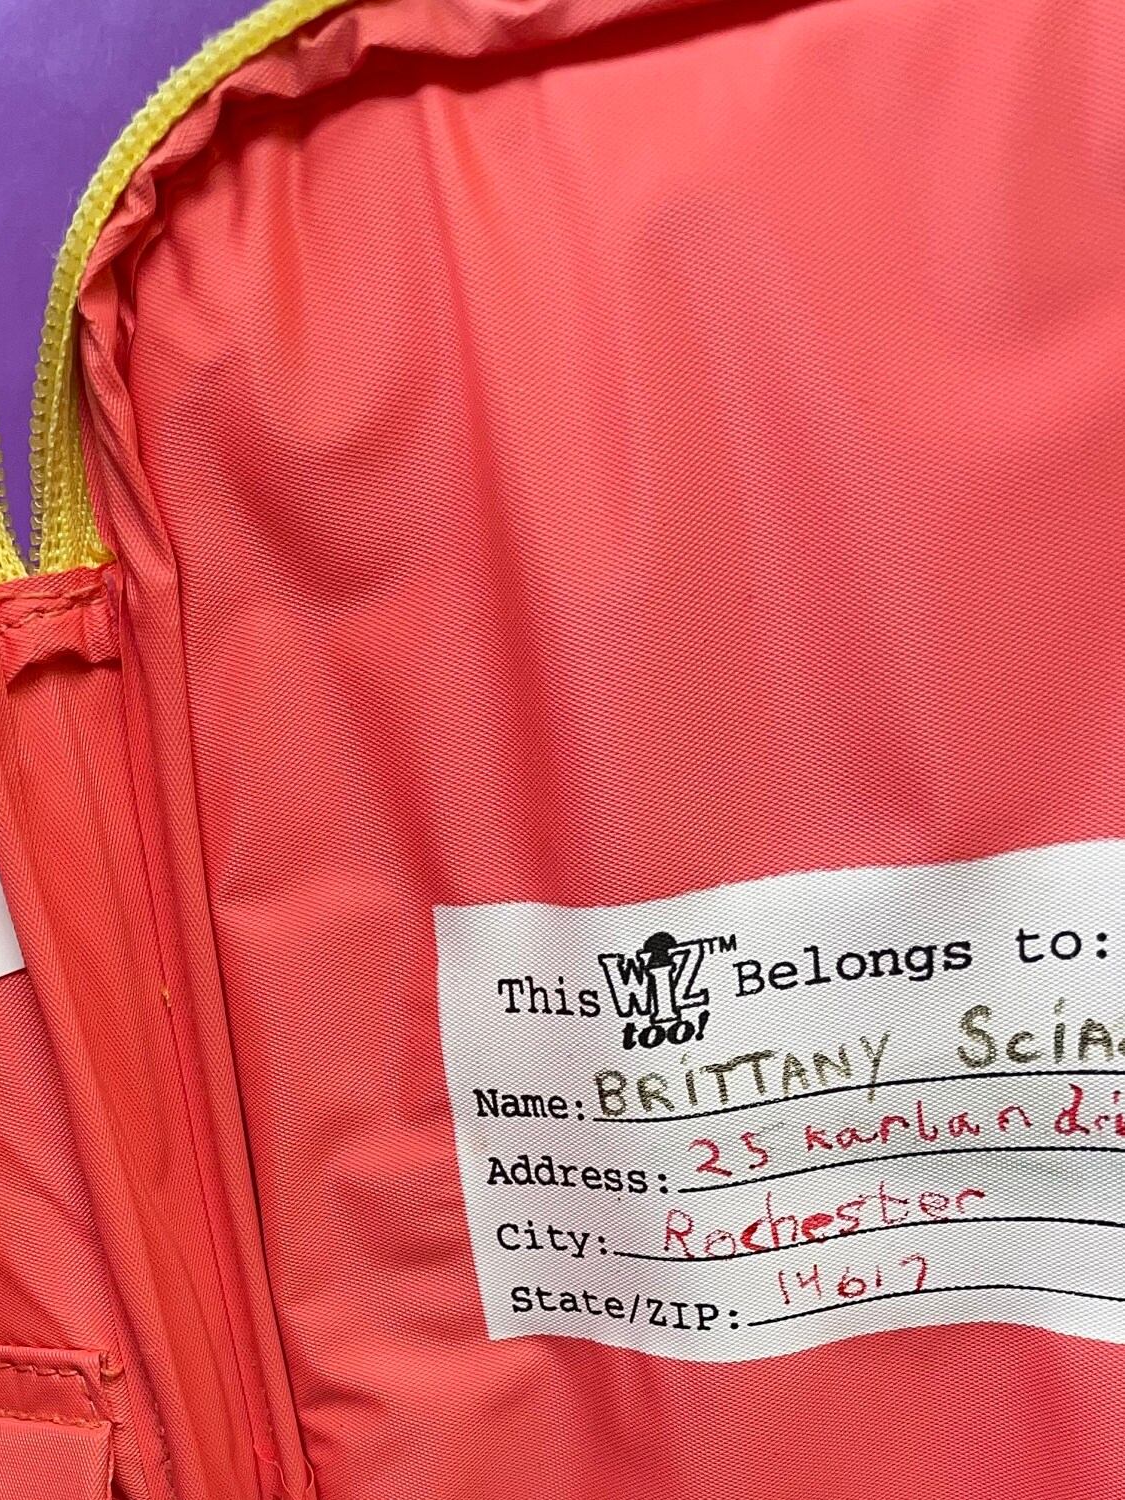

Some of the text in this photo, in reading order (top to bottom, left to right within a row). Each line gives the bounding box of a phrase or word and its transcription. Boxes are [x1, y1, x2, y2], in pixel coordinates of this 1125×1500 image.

[497, 976, 601, 1018] This
[732, 940, 973, 998] Belongs
[1017, 926, 1111, 963] to:
[622, 1010, 710, 1050] too!
[474, 1088, 586, 1122] Name:
[486, 1155, 670, 1195] Address:
[686, 1131, 770, 1177] 25
[496, 1222, 609, 1258] City:
[663, 1182, 987, 1260] Rochester
[776, 1254, 930, 1306] 14617
[511, 1285, 742, 1333] State/ZIP:
